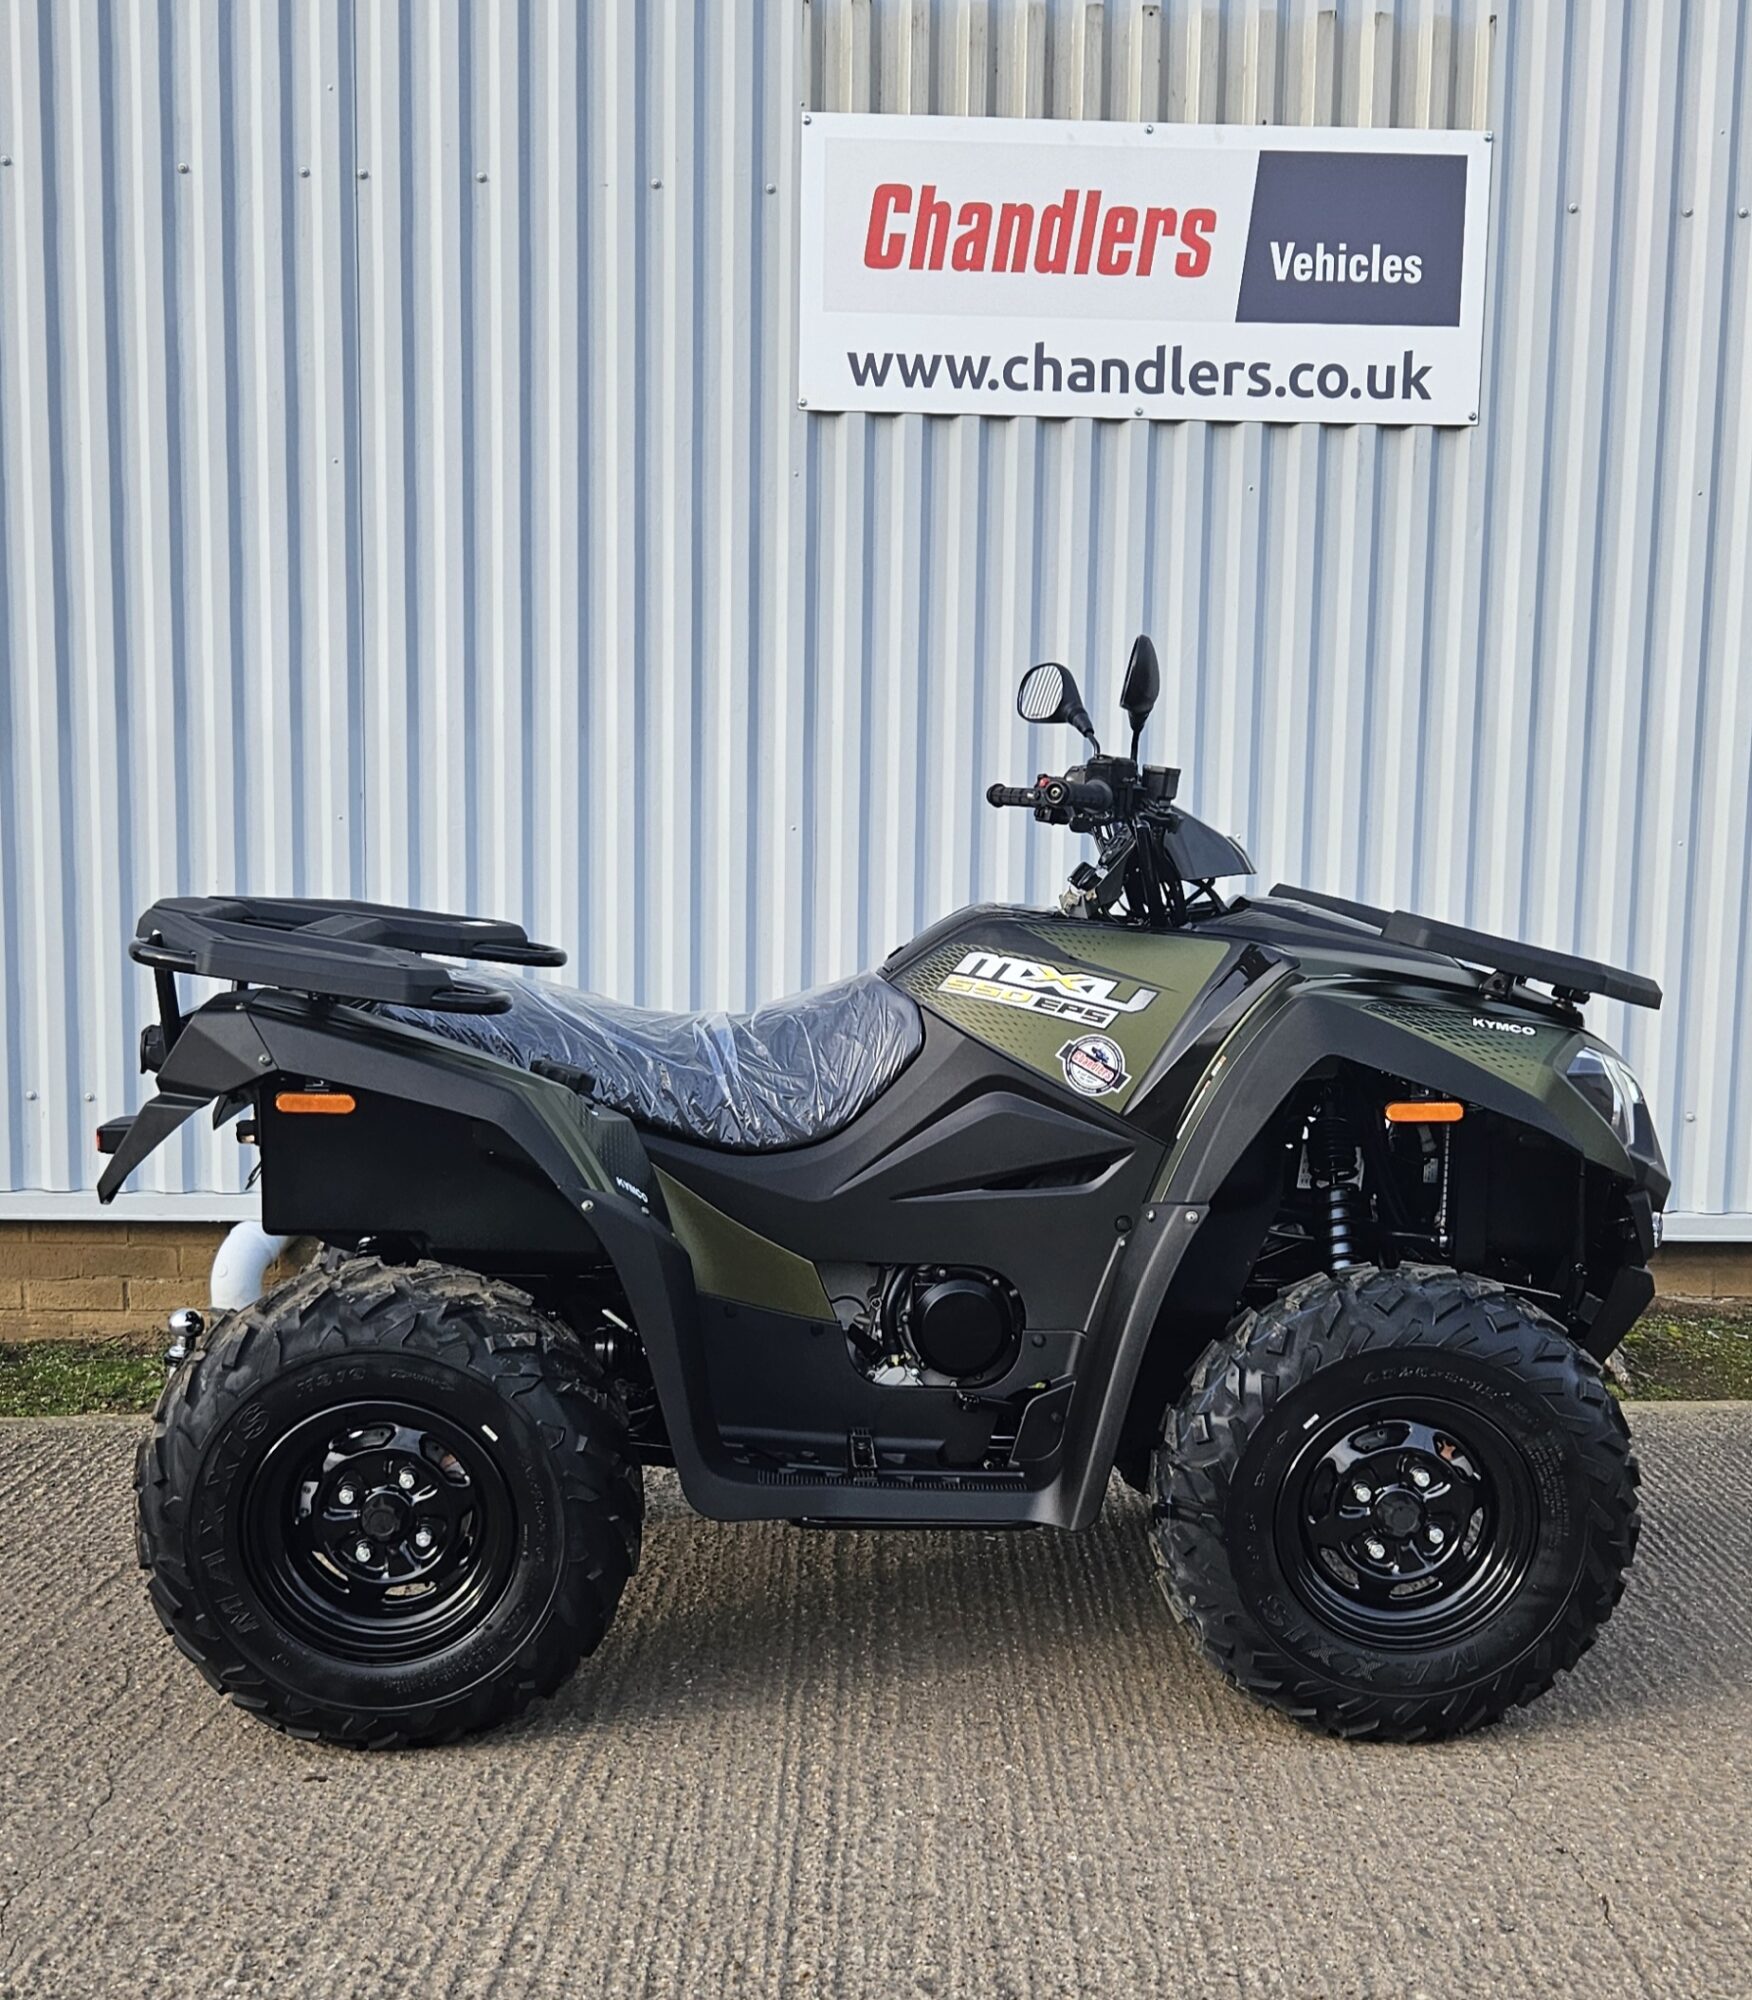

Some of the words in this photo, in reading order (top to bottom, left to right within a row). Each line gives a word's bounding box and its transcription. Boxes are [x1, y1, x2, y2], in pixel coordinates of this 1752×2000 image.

[863, 183, 1216, 278] Chandlers
[1270, 241, 1423, 285] Vehicles
[847, 342, 1432, 400] www.chandlers.co.uk
[946, 977, 1033, 1004] 550
[1034, 998, 1111, 1025] EPS
[1472, 1017, 1536, 1036] KYMCO
[1071, 1050, 1115, 1082] Chandlers
